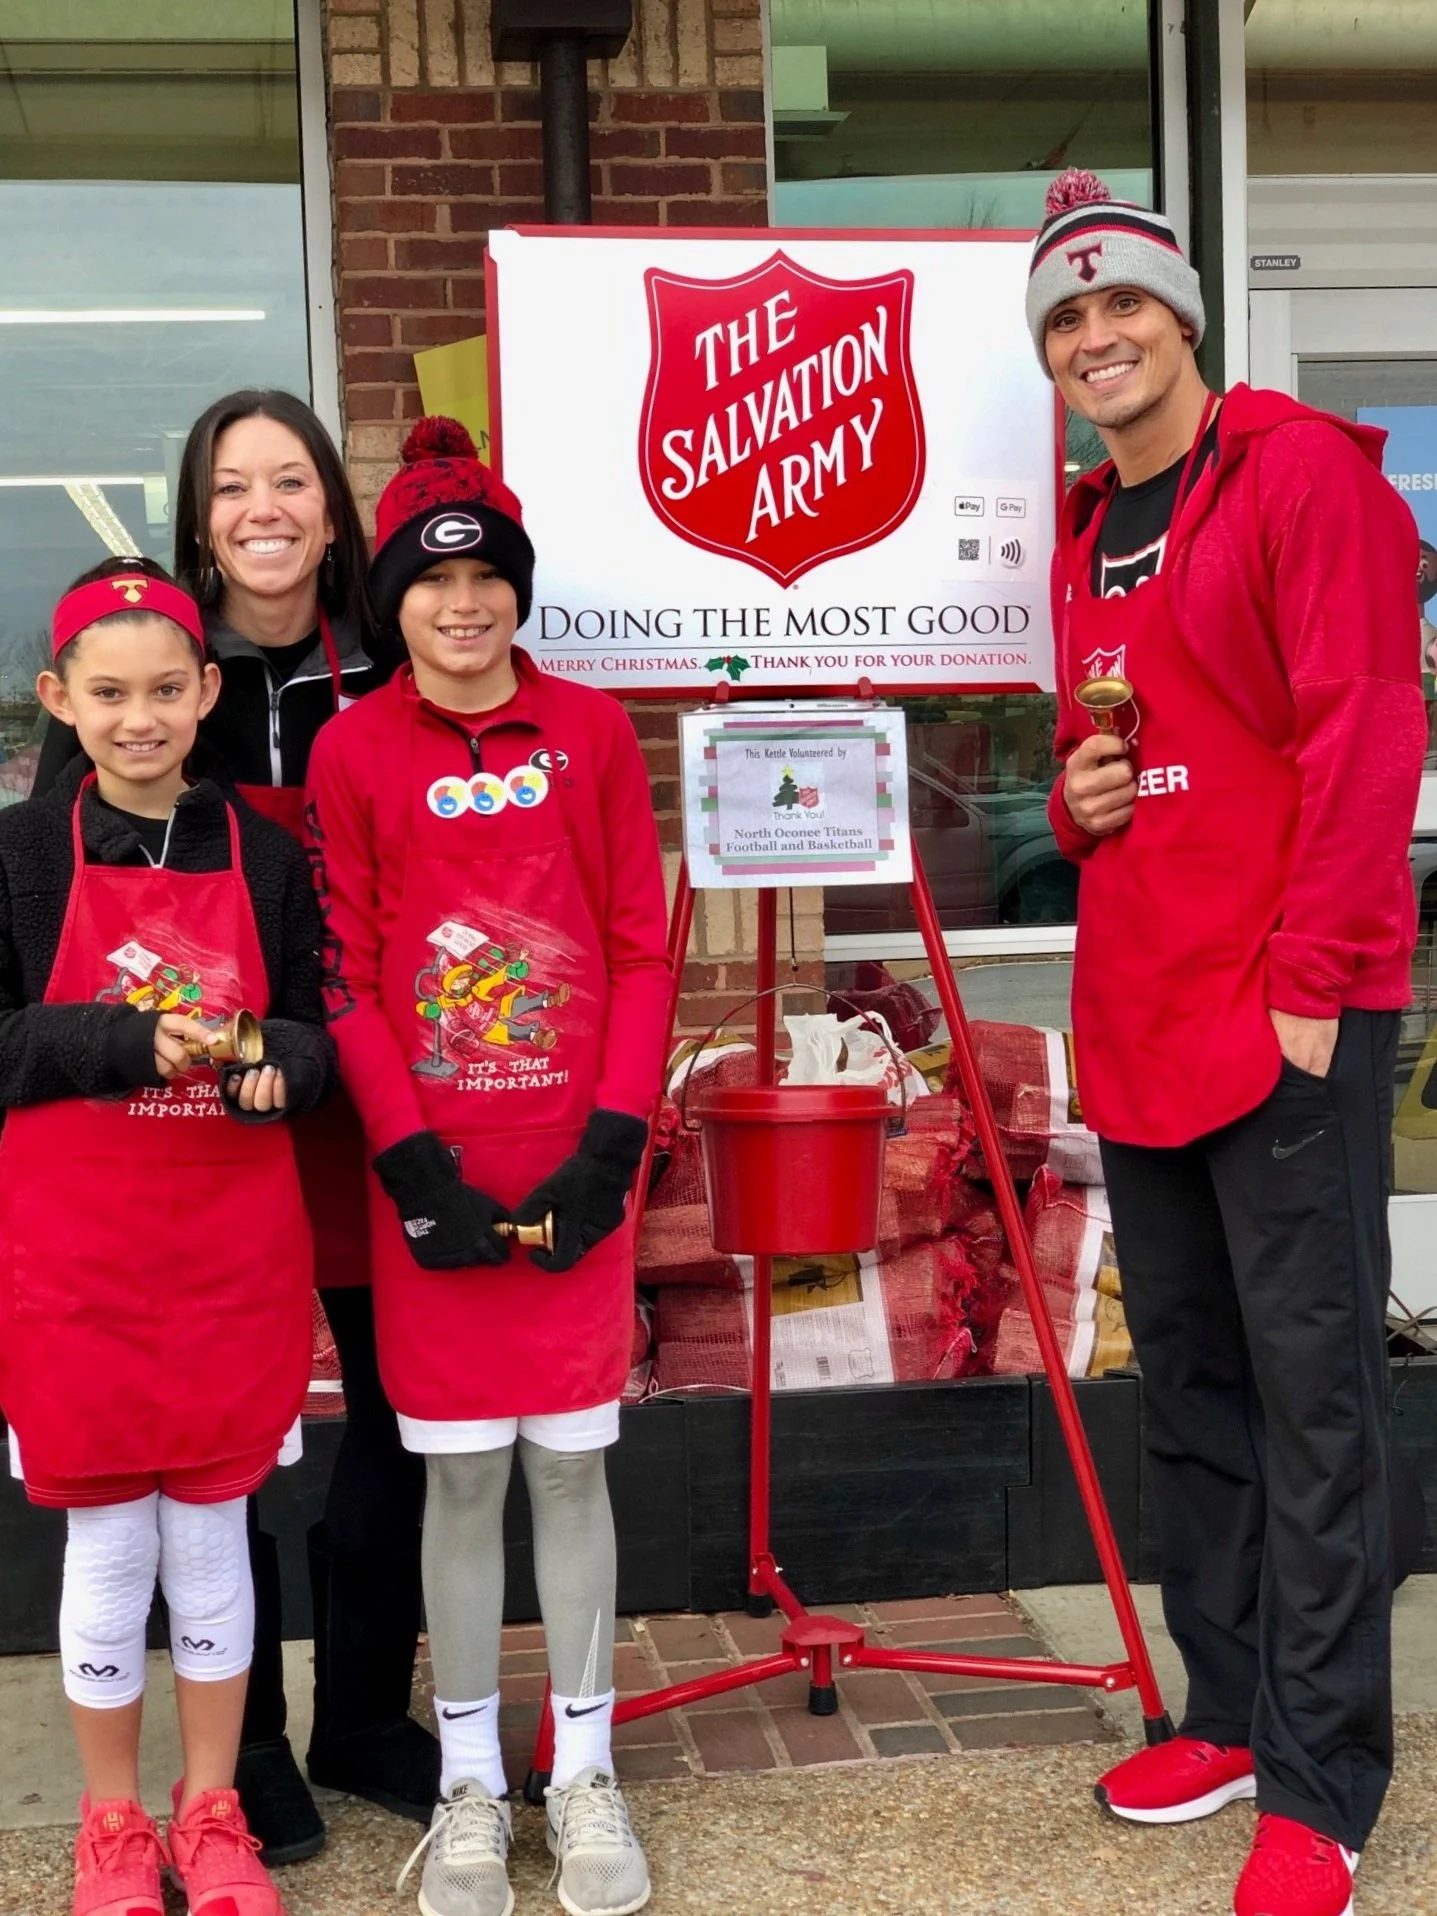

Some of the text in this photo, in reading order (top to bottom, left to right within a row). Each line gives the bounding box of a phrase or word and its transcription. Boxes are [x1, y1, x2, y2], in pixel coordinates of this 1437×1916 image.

[1253, 258, 1297, 268] STANLEY
[694, 289, 798, 392] THE
[661, 305, 889, 501] SALVATION
[745, 397, 884, 544] ARMY
[1387, 473, 1437, 490] FRES
[538, 604, 1030, 640] DOING THE MOST GOOD
[540, 653, 1032, 672] MERRY CHRISTMAS. THANK YOU FOR YOUR DONATION.
[745, 746, 847, 760] This Kettle Volunteered by
[1137, 764, 1190, 797] EER
[773, 810, 825, 821] Thank You!
[734, 826, 863, 840] North Oconee Titans
[726, 838, 872, 853] Football and Basketball
[467, 1056, 550, 1075] IT'S THAT
[457, 1069, 569, 1091] IMPORTANT!
[142, 1084, 220, 1099] IT'S THA
[128, 1102, 226, 1117] IMPORTA
[594, 1772, 611, 1785] NIKE
[452, 1784, 469, 1798] NIKE
